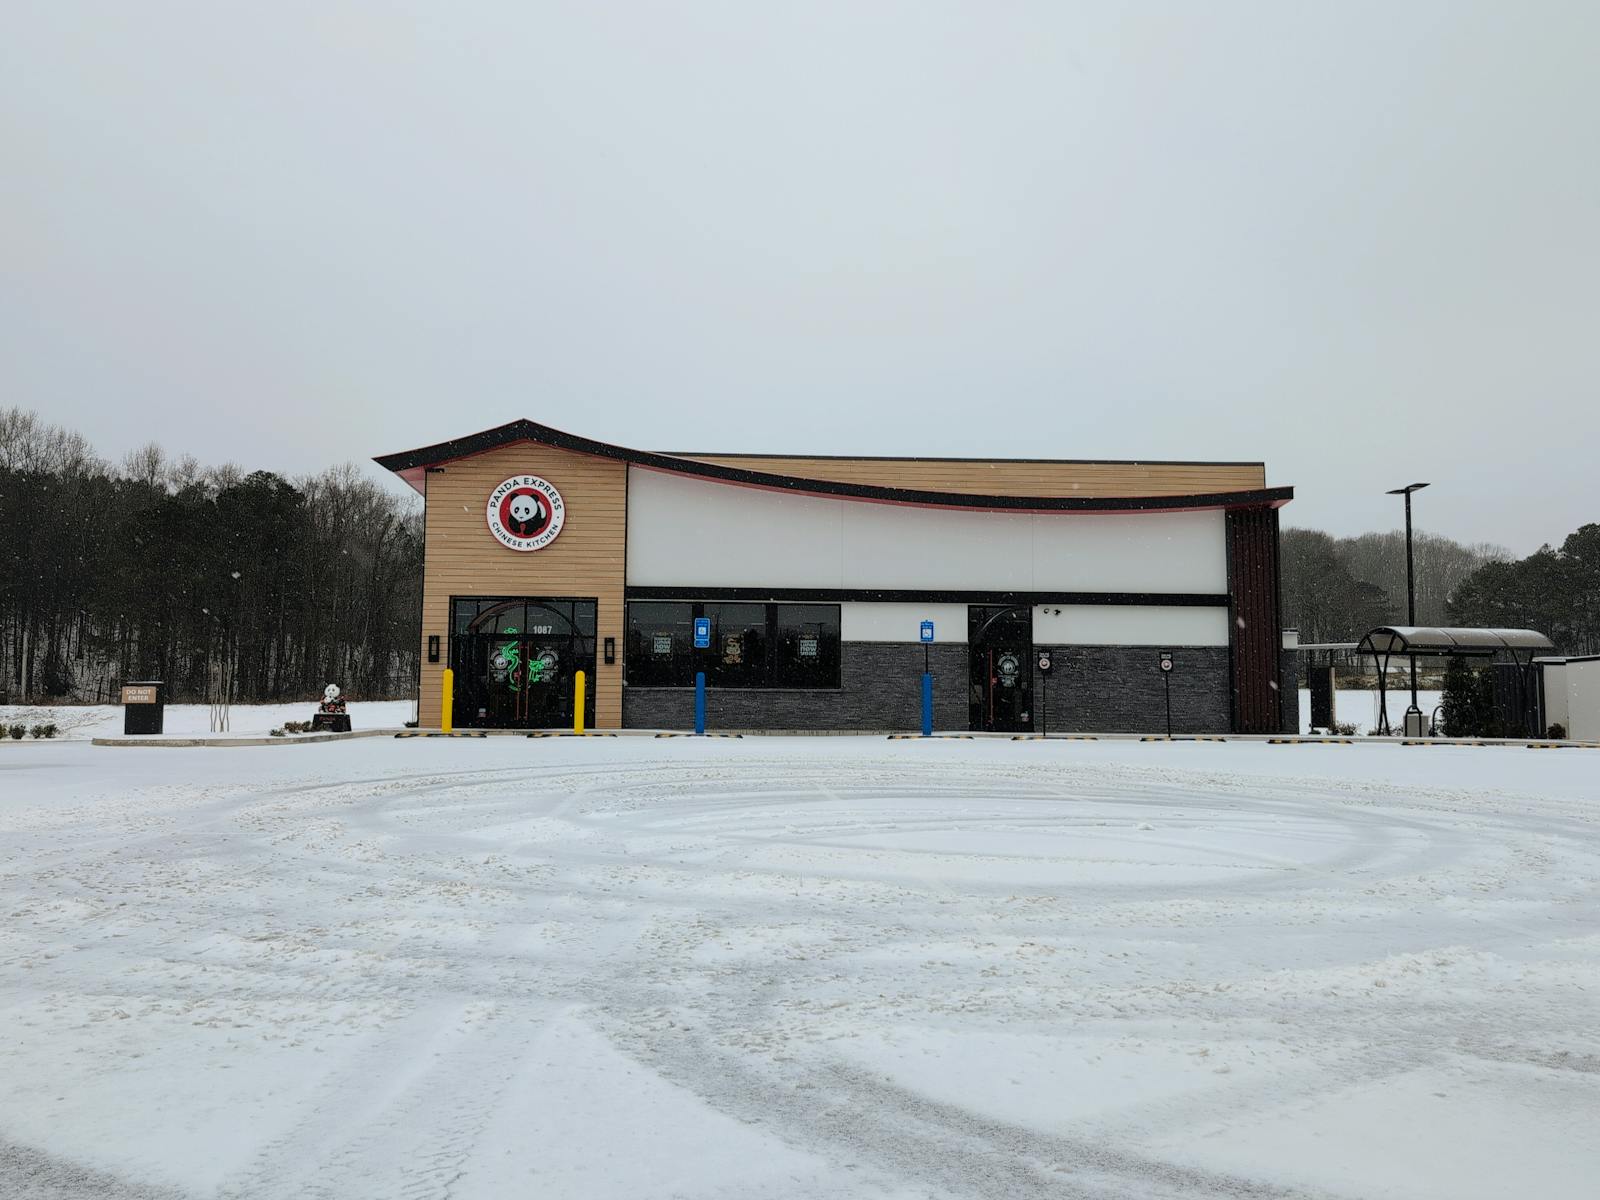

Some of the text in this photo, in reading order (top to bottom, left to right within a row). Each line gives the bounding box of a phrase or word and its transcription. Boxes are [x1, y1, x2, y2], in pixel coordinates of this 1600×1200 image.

[490, 477, 562, 511] PANDA EXPRESS
[492, 521, 558, 548] CHINESE KITCHEN
[533, 625, 553, 635] 1087
